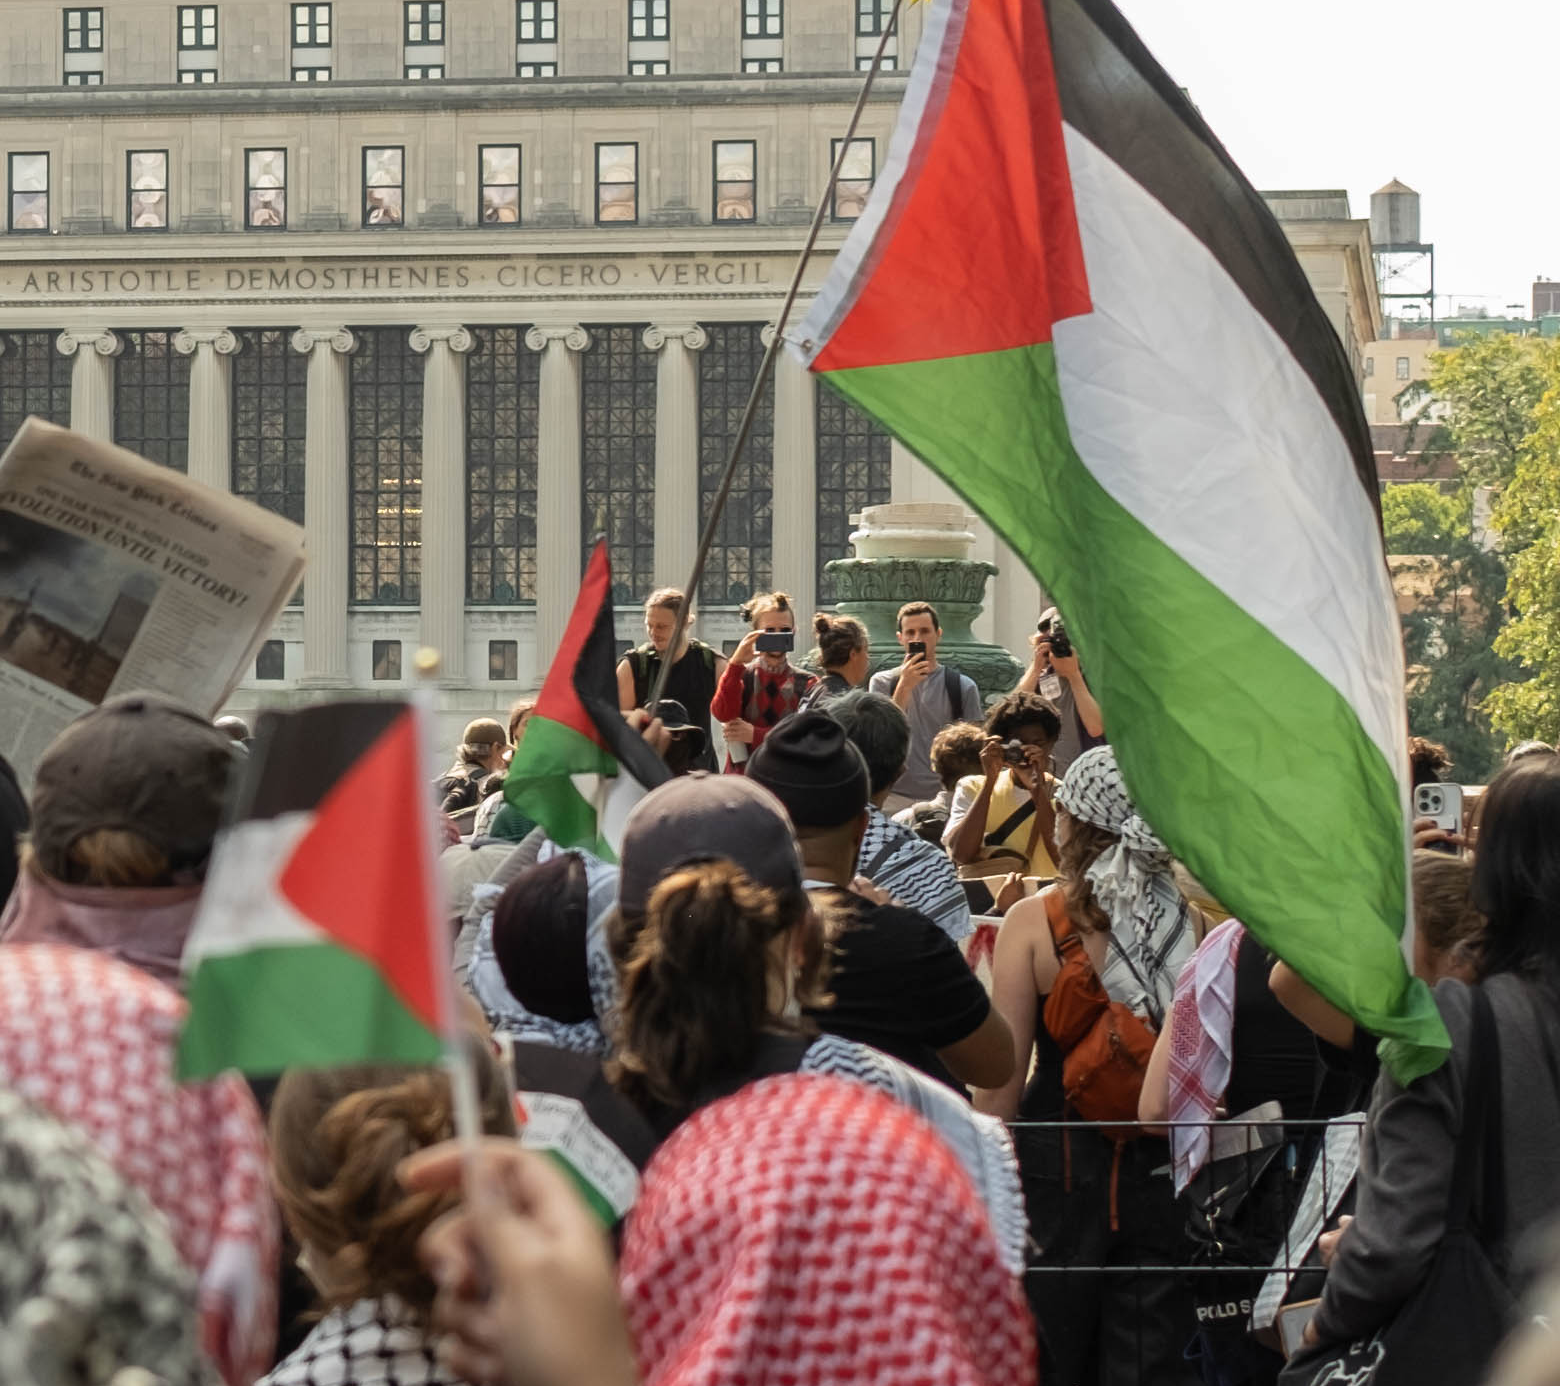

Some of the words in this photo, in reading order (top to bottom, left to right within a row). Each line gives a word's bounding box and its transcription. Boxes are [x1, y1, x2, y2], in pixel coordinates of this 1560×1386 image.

[21, 268, 202, 294] ARISTOTLE
[226, 265, 471, 292] DEMOSTHENES
[497, 263, 623, 289] CICERO
[647, 261, 771, 285] VERGIL
[102, 527, 157, 564] UNTIL
[162, 556, 249, 608] VICTORY!
[1196, 1301, 1238, 1322] POLO
